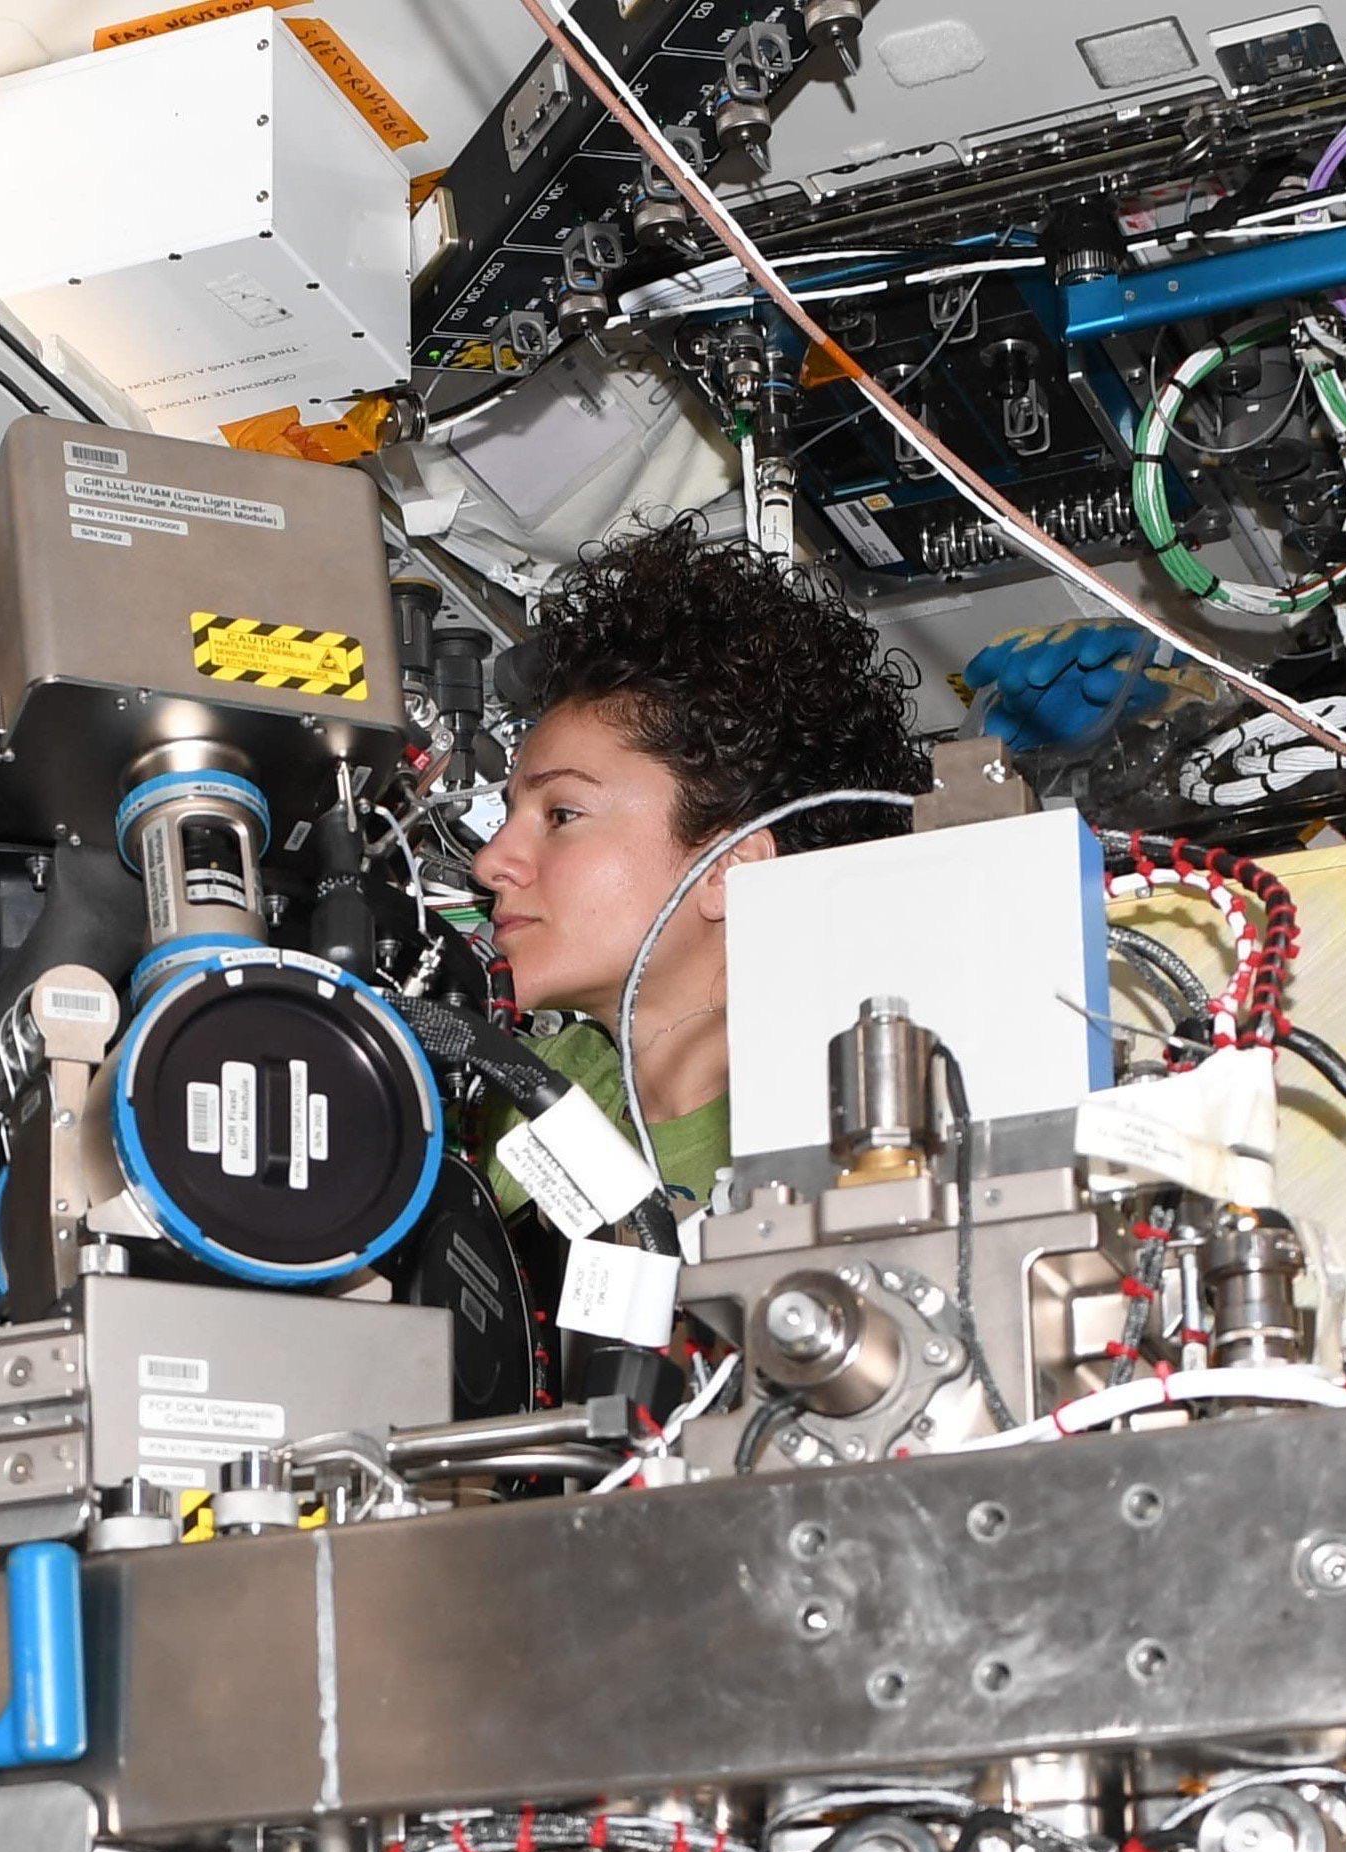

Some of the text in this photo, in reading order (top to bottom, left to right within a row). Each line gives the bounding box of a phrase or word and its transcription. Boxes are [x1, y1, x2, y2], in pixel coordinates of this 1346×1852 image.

[717, 28, 736, 43] ON
[297, 29, 408, 138] SPECTROMETER
[530, 182, 569, 220] 120 VDC
[555, 227, 572, 240] ON
[450, 307, 468, 321] 120
[482, 316, 499, 328] ON
[239, 352, 264, 364] BOX
[267, 345, 297, 358] THIS
[207, 360, 235, 372] HAS
[127, 369, 193, 390] LOCATION
[214, 373, 296, 397] COORDINATE
[83, 477, 266, 514] CIR LLL-UV IAM (Low Light Level-
[74, 485, 278, 526] Ultraviolet Image Acquisition Module)
[227, 632, 291, 650] CAUTION
[214, 639, 239, 650] PARTS
[261, 645, 312, 661] ASSEMBLIES
[215, 648, 255, 660] SENSITIVE
[216, 657, 283, 677] ELECTROSTATIC
[203, 782, 228, 794] LOCK
[233, 950, 278, 962] UNLOCK
[228, 1089, 237, 1145] CIR Fixed
[240, 1079, 249, 1159] Mirror Module
[147, 1400, 172, 1410] FCF
[176, 1401, 204, 1412] DCM
[165, 1413, 208, 1426] Control
